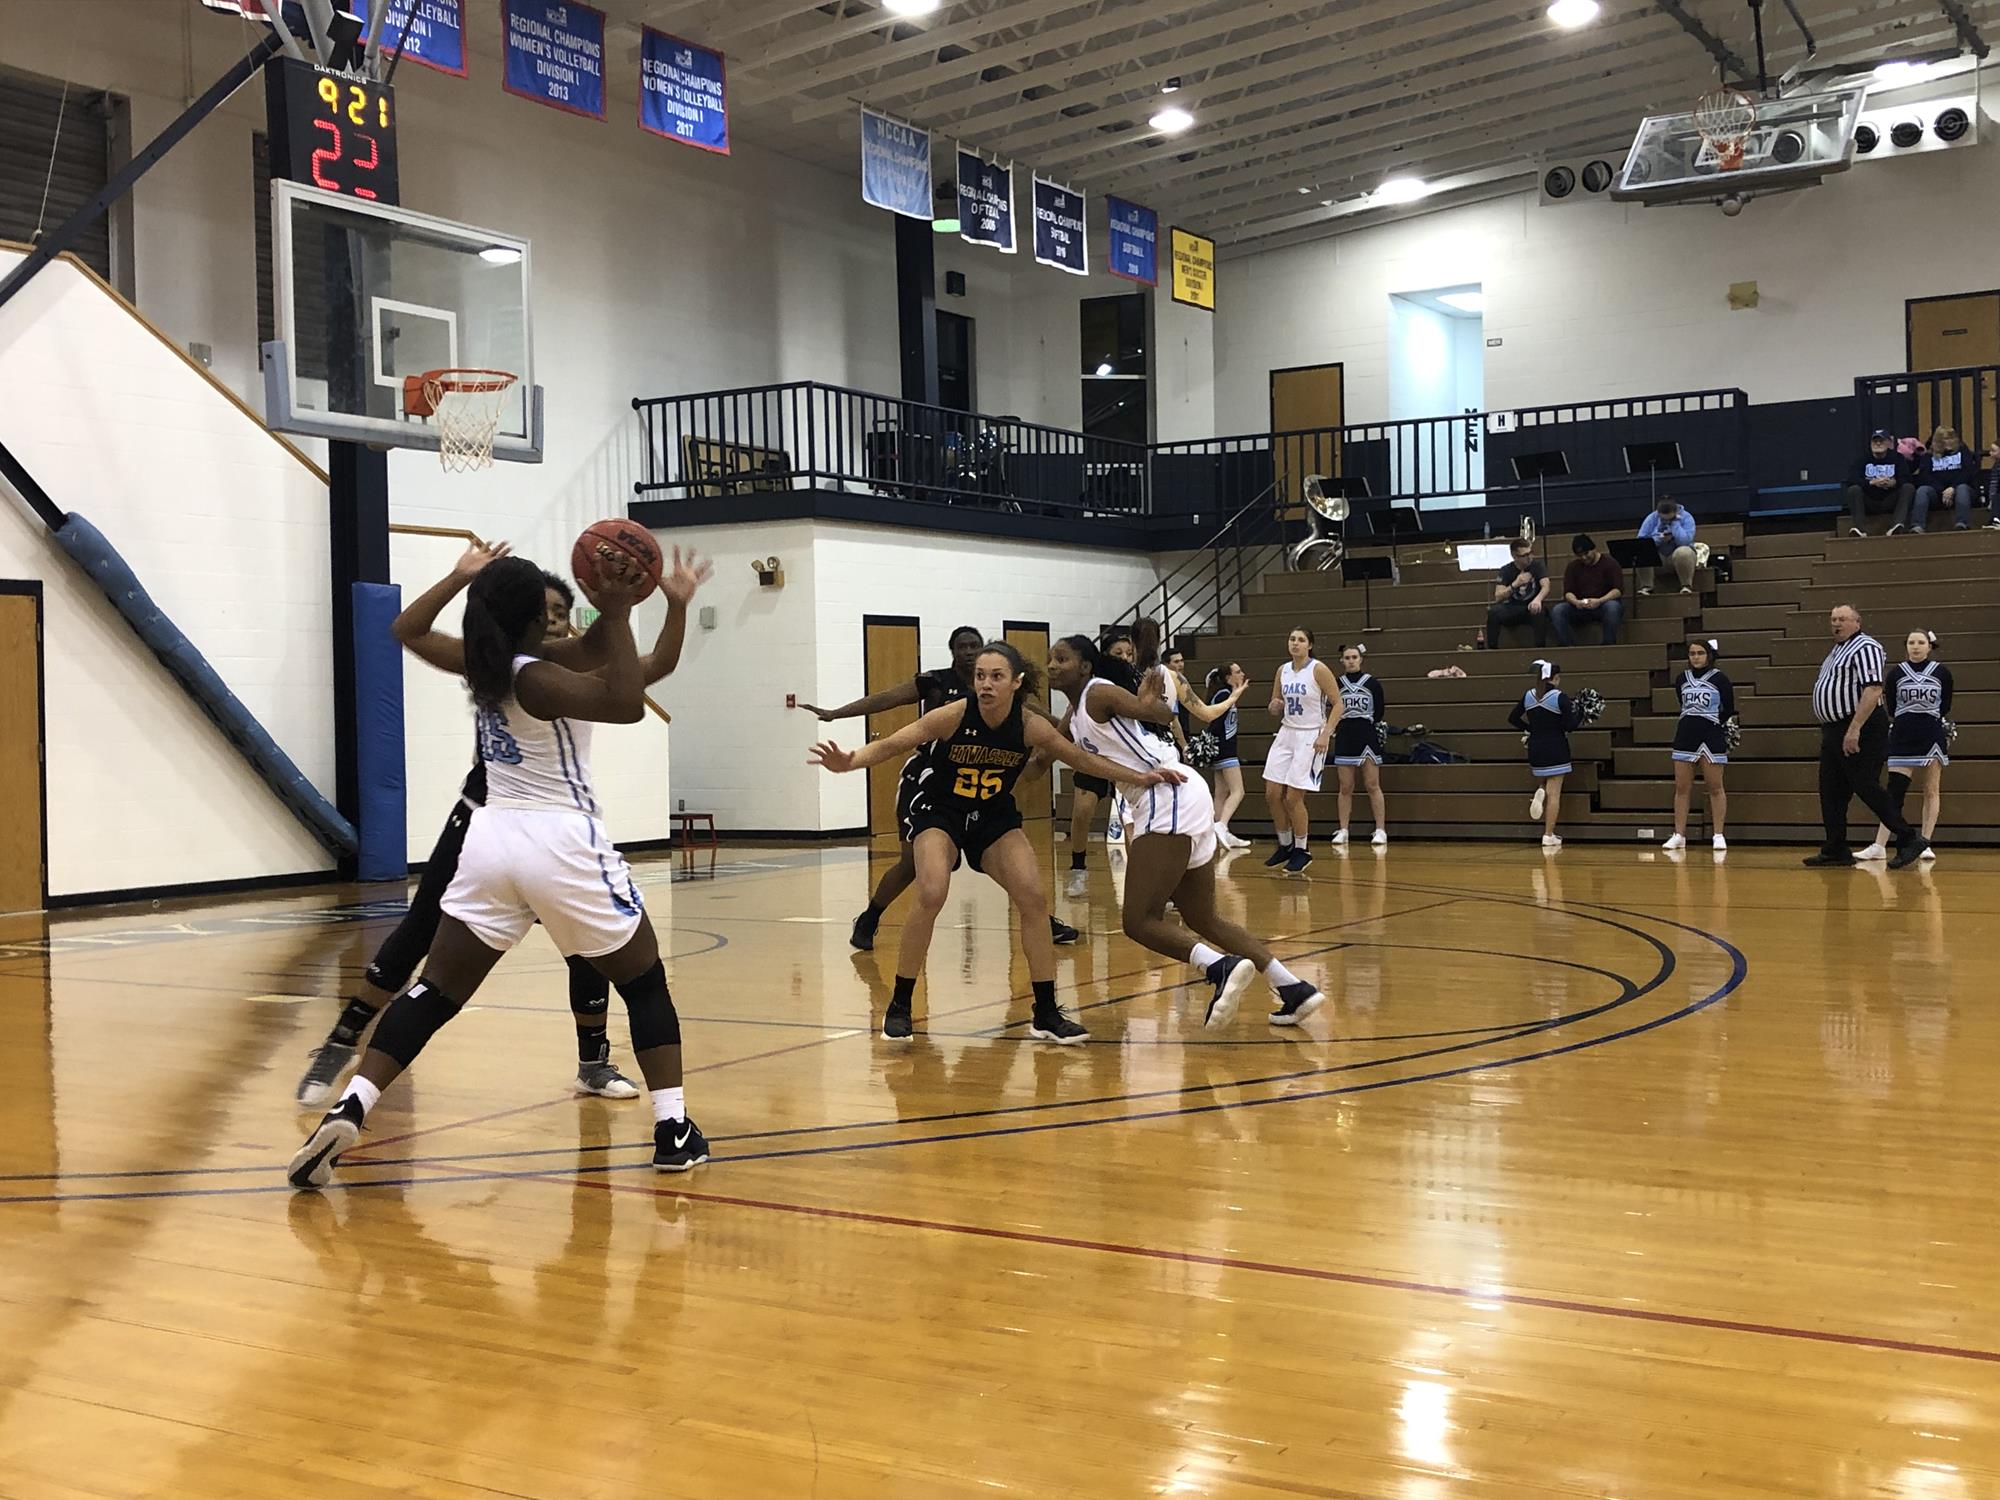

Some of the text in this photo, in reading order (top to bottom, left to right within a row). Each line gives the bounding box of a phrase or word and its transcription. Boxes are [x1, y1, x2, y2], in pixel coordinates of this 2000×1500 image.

[404, 0, 460, 29] VOLEYBALL
[397, 33, 421, 54] 012
[510, 13, 552, 41] REGIONAL
[554, 29, 600, 58] CHAMPIONS
[510, 32, 600, 76] WOMEN'S VOLLEYBALL
[314, 64, 367, 84] DAKTRONICS
[536, 59, 574, 84] DIVISION
[643, 58, 680, 82] REGIONAL
[681, 72, 722, 96] CHAMPIONS
[548, 82, 569, 100] 2013
[643, 74, 680, 99] WOMEN'S
[667, 99, 699, 122] DIVISION
[676, 120, 693, 137] 2017
[877, 120, 916, 148] NCCAA
[960, 183, 1008, 212] REGINAL CHAMPNS
[1498, 414, 1505, 427] H
[1283, 683, 1307, 695] OAKS
[1900, 688, 1938, 704] OAKS
[1286, 697, 1304, 716] 24
[1343, 697, 1369, 710] AKS
[953, 768, 1005, 800] 25
